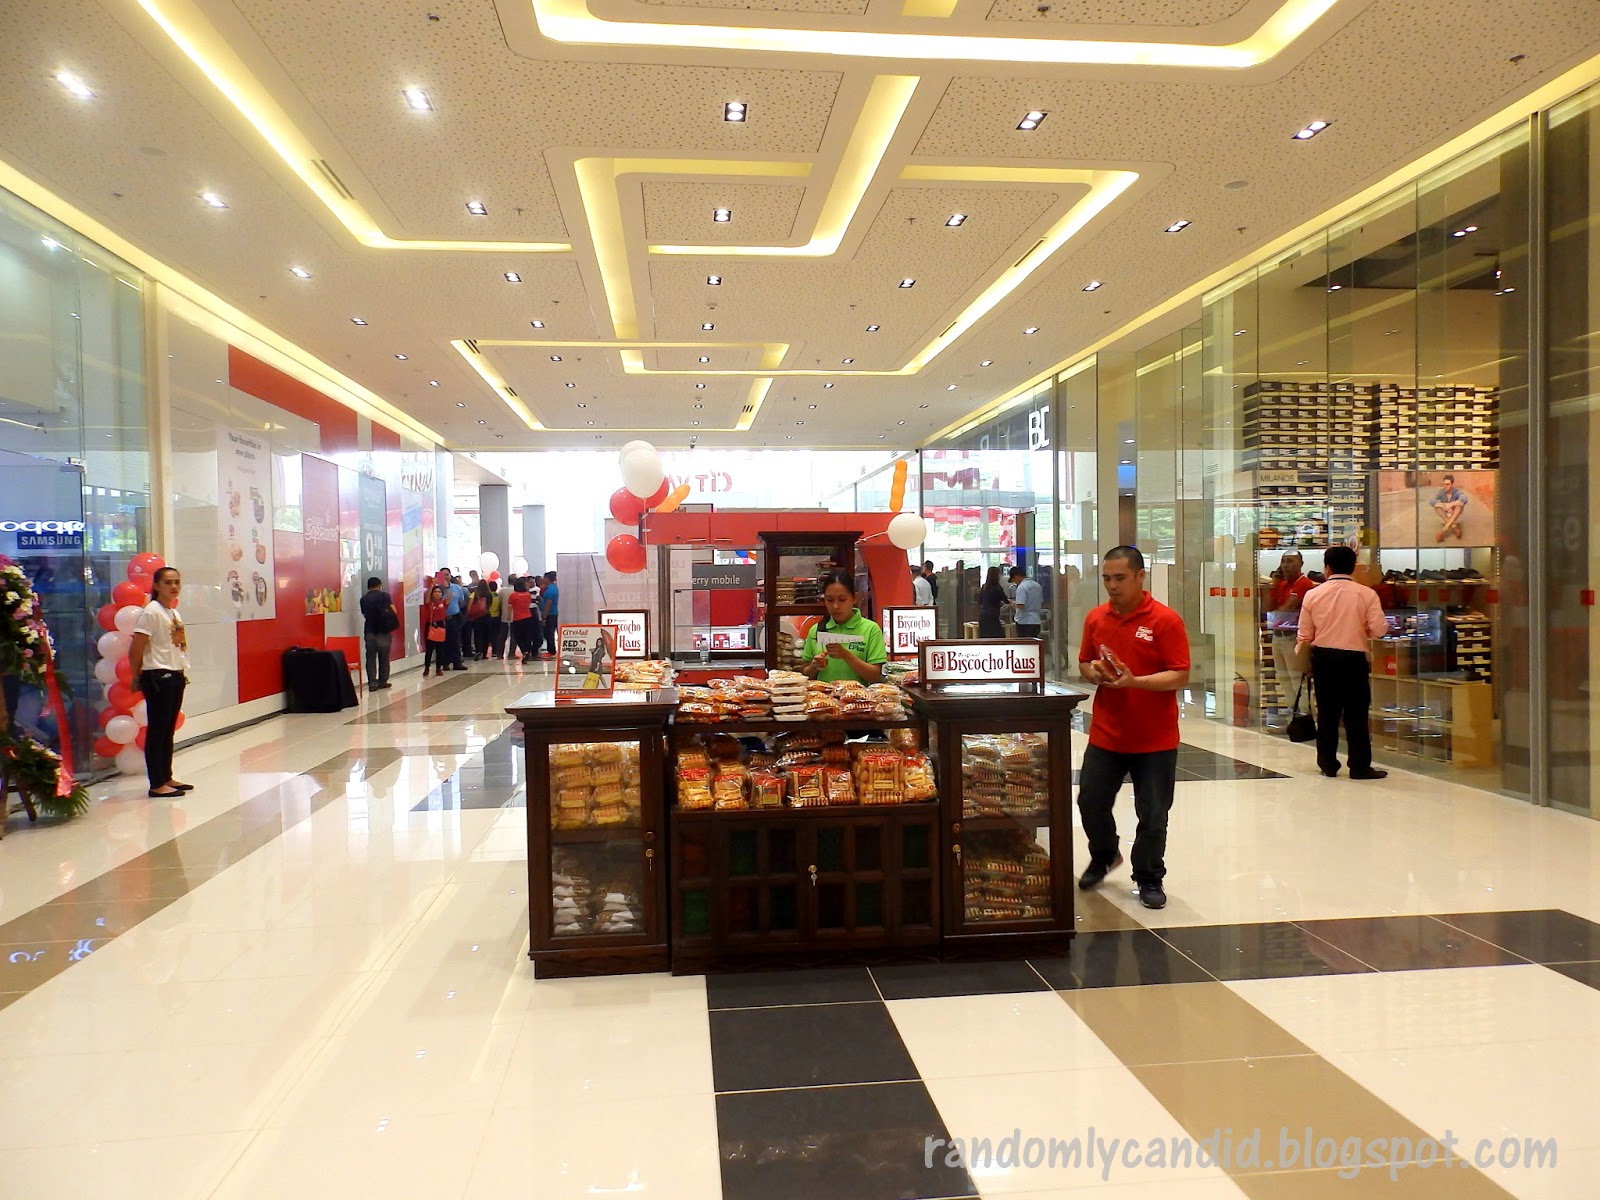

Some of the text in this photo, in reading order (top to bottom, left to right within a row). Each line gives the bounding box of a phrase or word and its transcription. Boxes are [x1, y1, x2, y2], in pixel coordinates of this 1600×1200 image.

[21, 535, 81, 546] SAMSUNG
[366, 532, 374, 572] 9
[711, 574, 741, 585] mobile
[897, 615, 931, 631] Biscocho
[562, 640, 579, 648] RED
[619, 635, 641, 651] Haus
[946, 649, 1036, 674] Biscocho Haus
